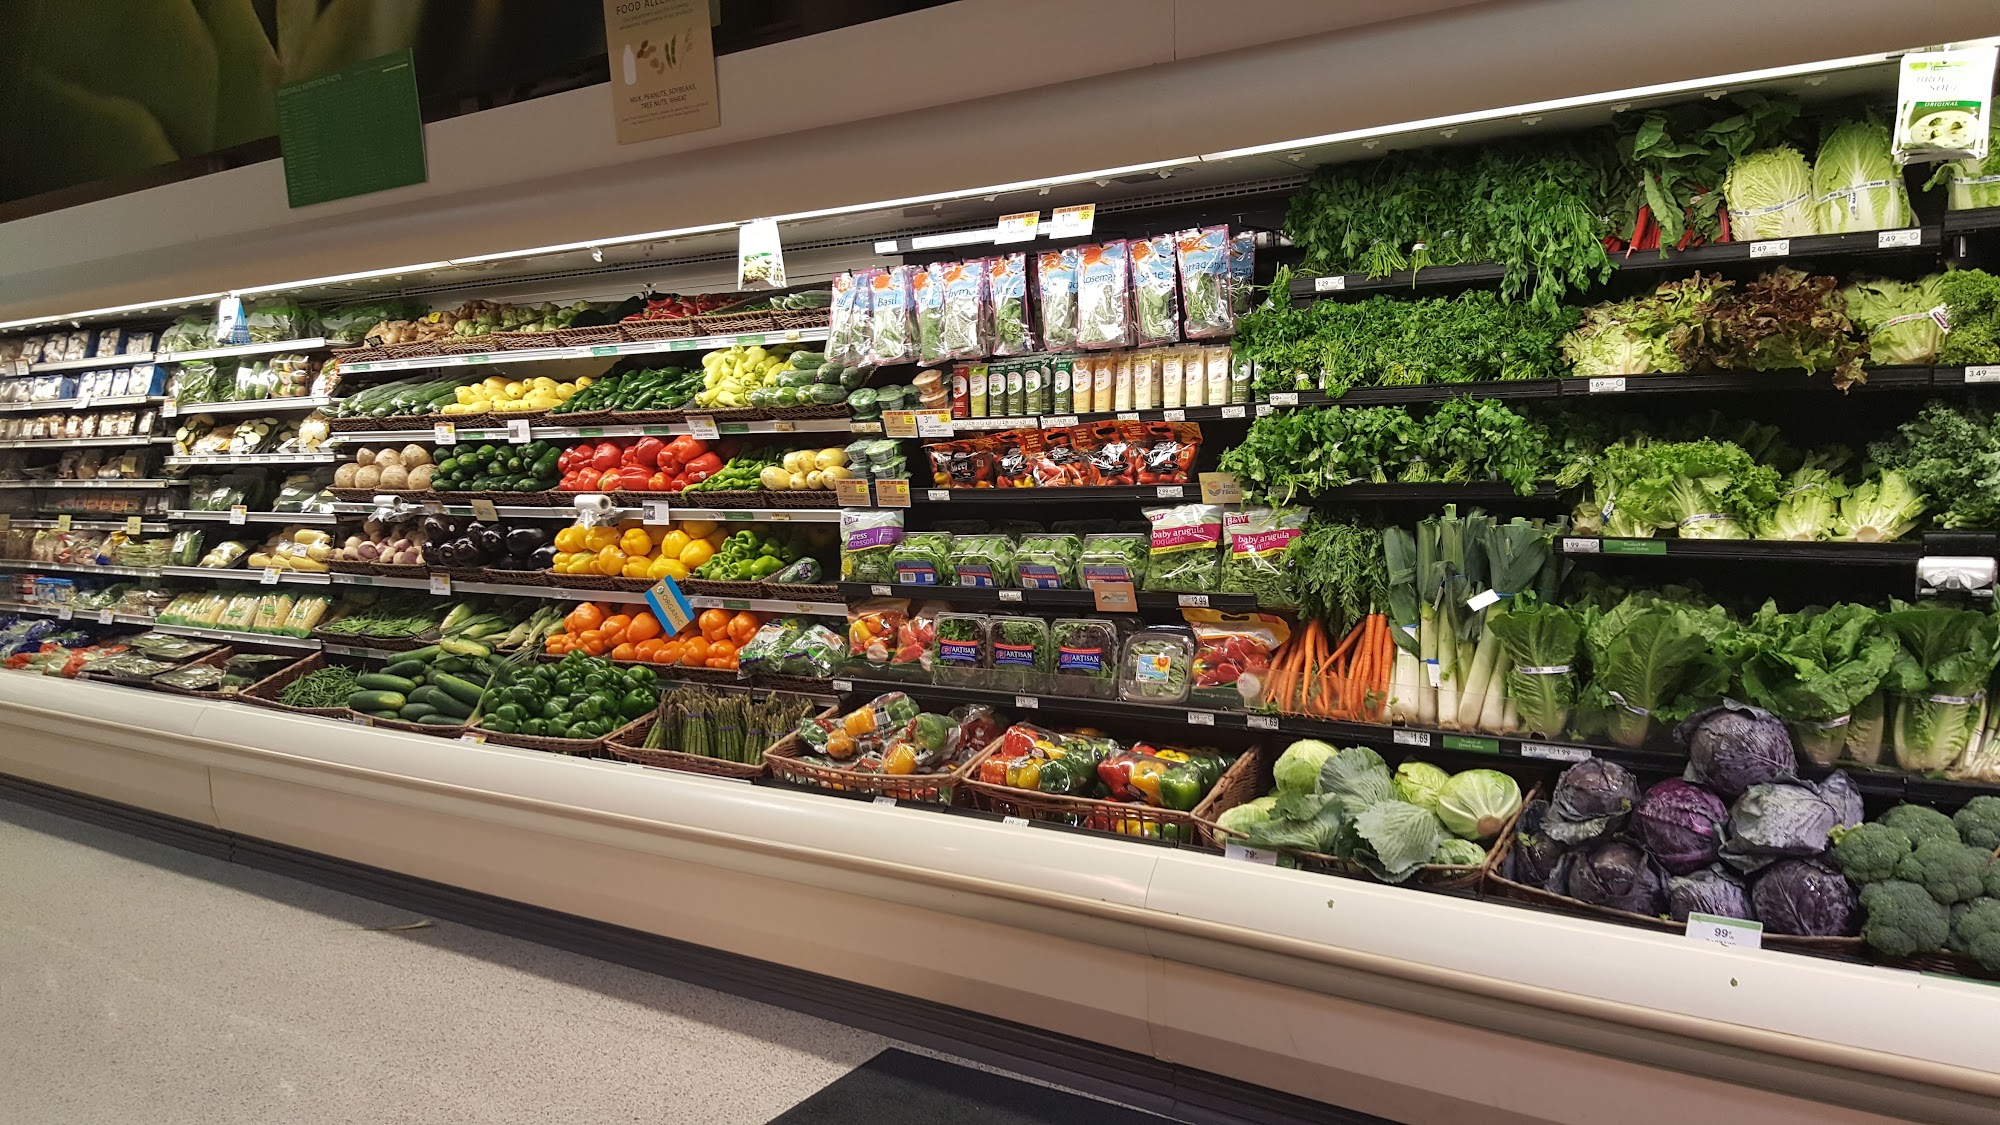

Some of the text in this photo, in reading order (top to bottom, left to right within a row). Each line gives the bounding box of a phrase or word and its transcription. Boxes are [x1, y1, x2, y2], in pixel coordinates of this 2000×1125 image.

[616, 1, 641, 15] FOOD
[877, 294, 898, 307] Basil
[1227, 515, 1246, 526] B&W
[1153, 526, 1204, 540] baby arugula
[1238, 531, 1290, 544] baby arugula
[850, 538, 874, 547] cresson
[1153, 536, 1185, 546] roquette
[1191, 596, 1207, 605] $2.99
[662, 594, 684, 626] ORGANIC
[1006, 651, 1032, 659] ARTISAN
[1071, 655, 1099, 663] ARTISAN
[1262, 717, 1278, 727] $1.69
[1410, 732, 1428, 744] $1.69
